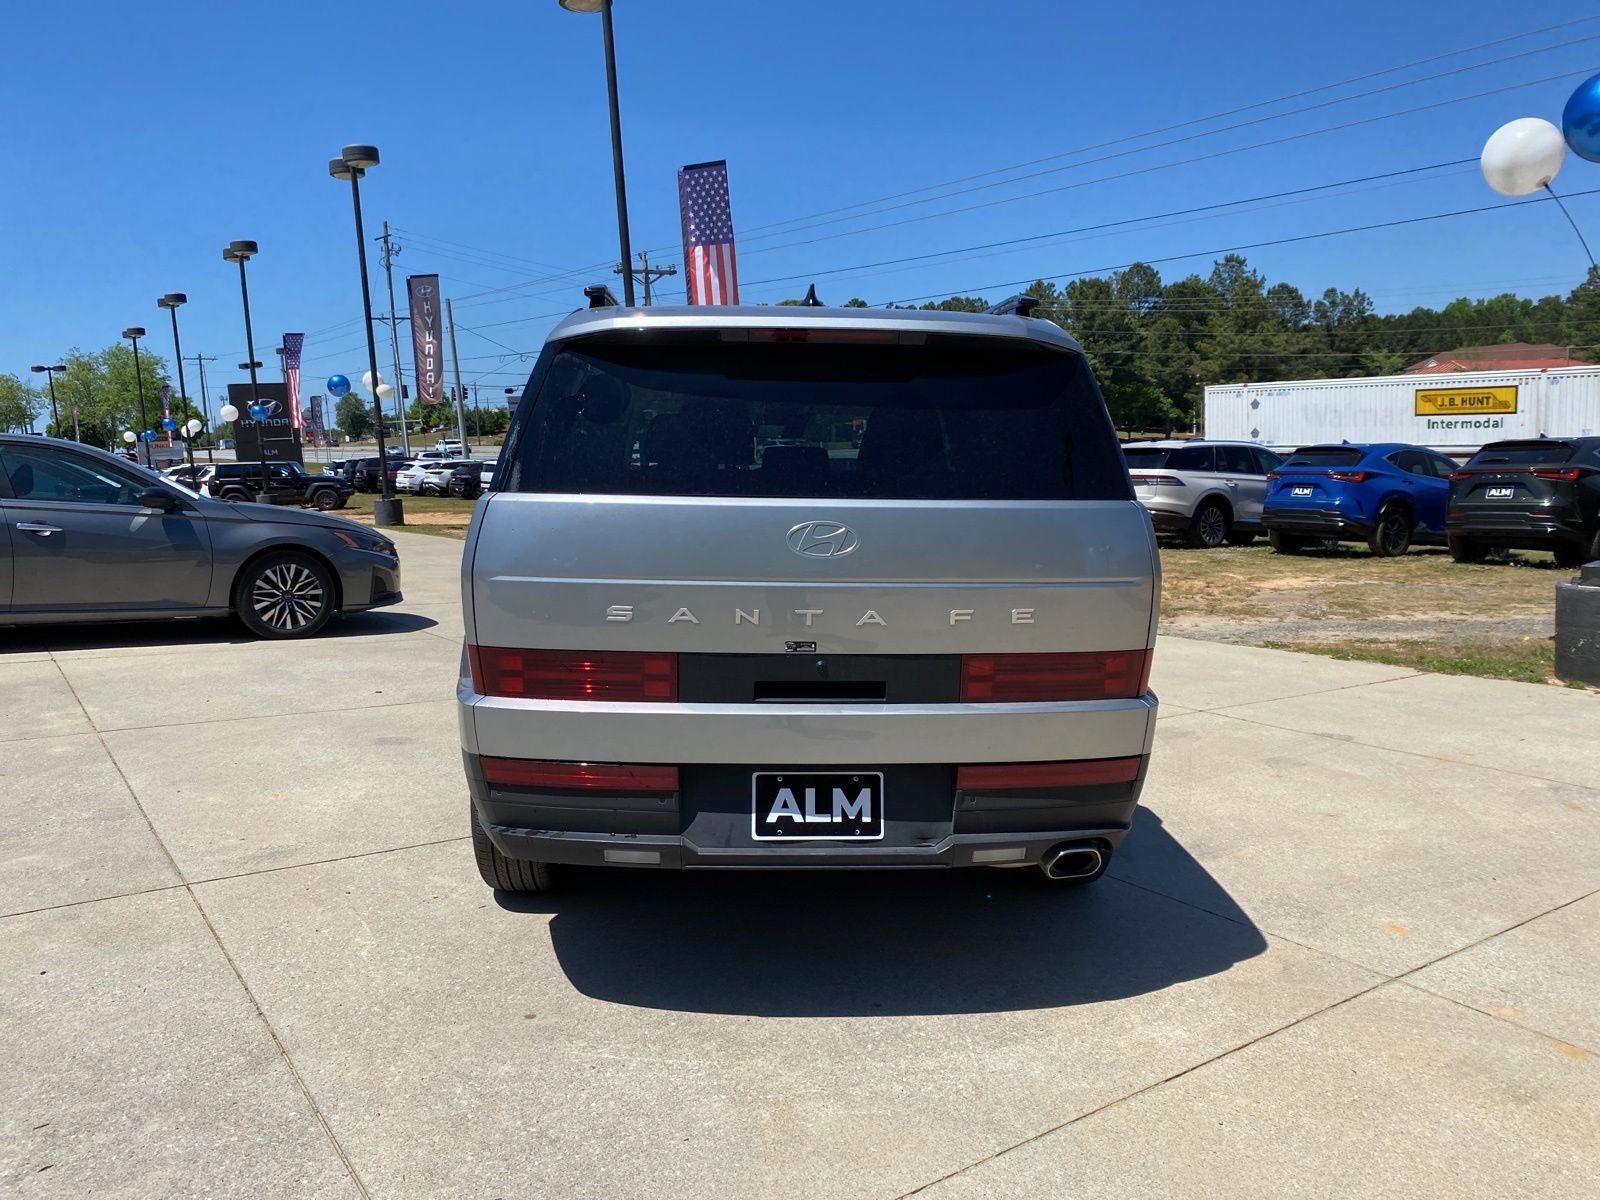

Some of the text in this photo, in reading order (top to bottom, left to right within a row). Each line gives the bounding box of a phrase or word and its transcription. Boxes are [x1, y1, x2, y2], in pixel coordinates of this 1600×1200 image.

[423, 301, 435, 397] HYUNDAI
[1438, 396, 1491, 407] J.B. HUNT
[1427, 417, 1504, 430] Intermodal
[1293, 487, 1311, 495] ALM
[1488, 488, 1512, 496] ALM
[605, 604, 1036, 627] SANTA FE
[765, 787, 872, 823] ALM
